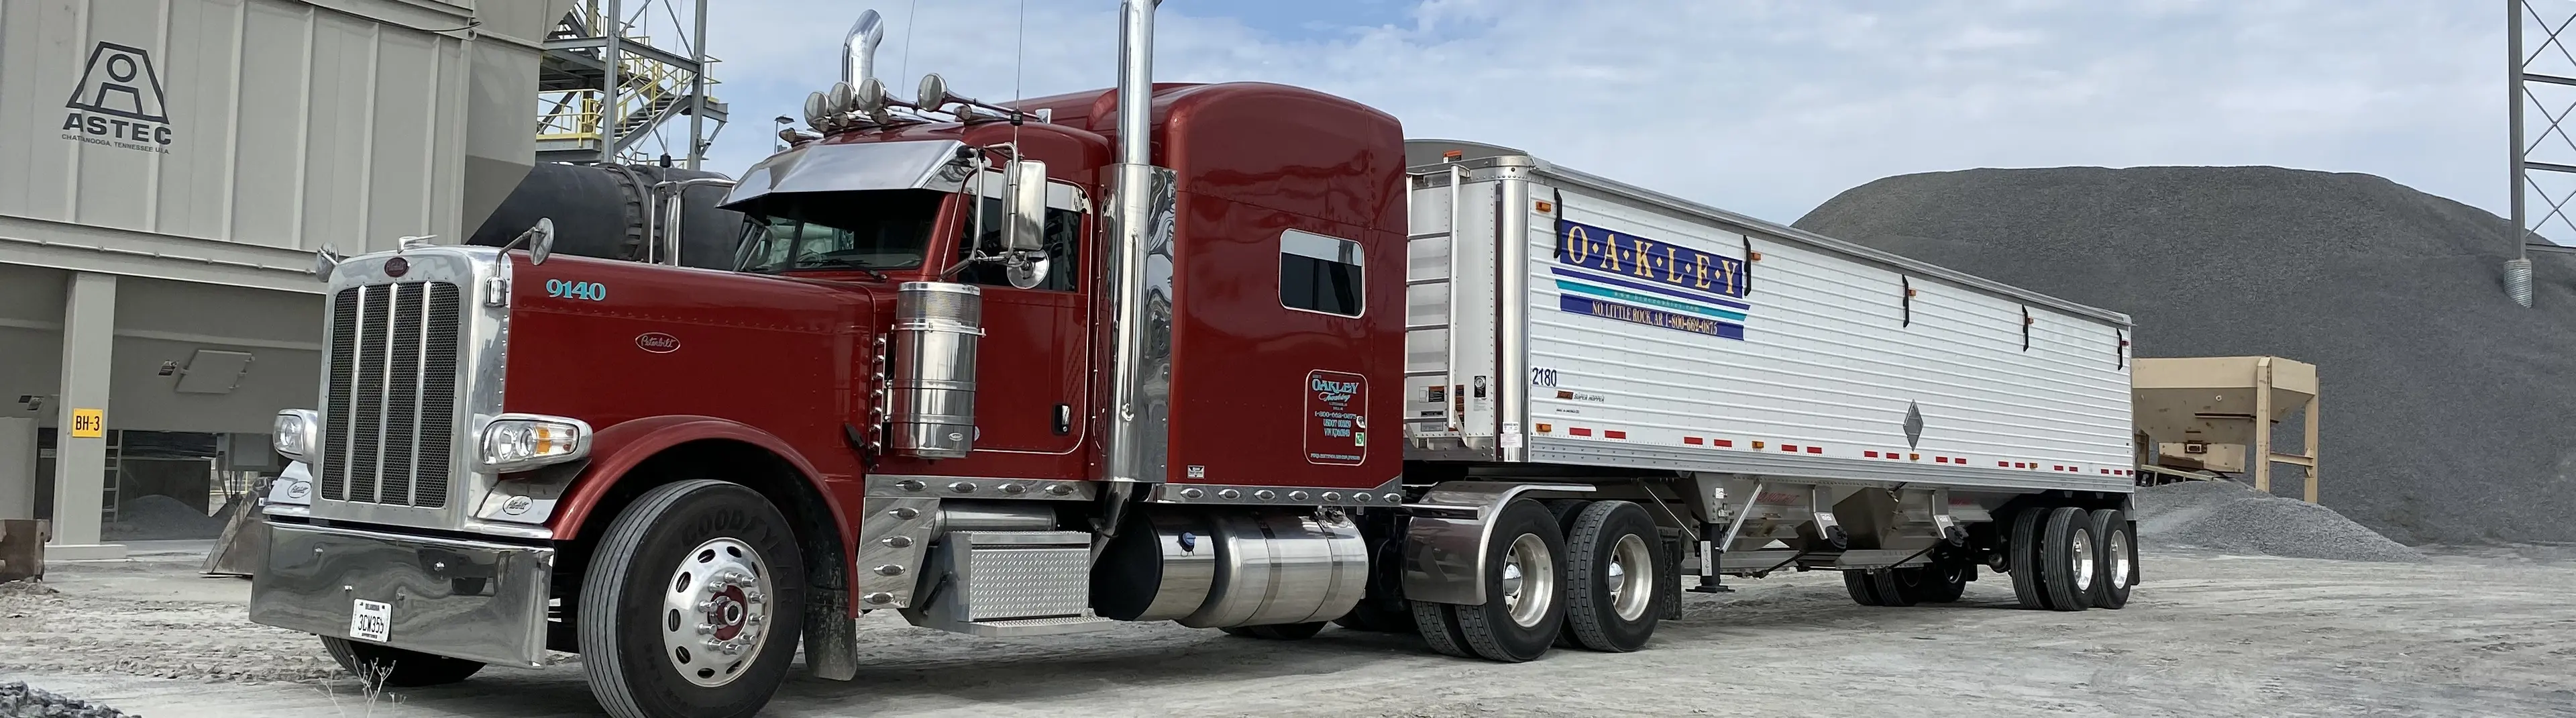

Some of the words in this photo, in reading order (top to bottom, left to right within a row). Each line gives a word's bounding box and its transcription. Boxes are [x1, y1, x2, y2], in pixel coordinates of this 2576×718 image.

[62, 113, 172, 145] ASTEC
[114, 142, 153, 152] TENNESSEE
[546, 278, 606, 301] 9140
[1592, 301, 1605, 315] NO.
[1605, 303, 1631, 321] LITTLE
[1633, 308, 1654, 326] ROCK,
[1654, 313, 1664, 327] AR
[641, 336, 676, 348] Peterbilt
[1311, 378, 1359, 394] OAKLEY
[1532, 367, 1557, 387] 2180
[76, 415, 100, 431] BH-3
